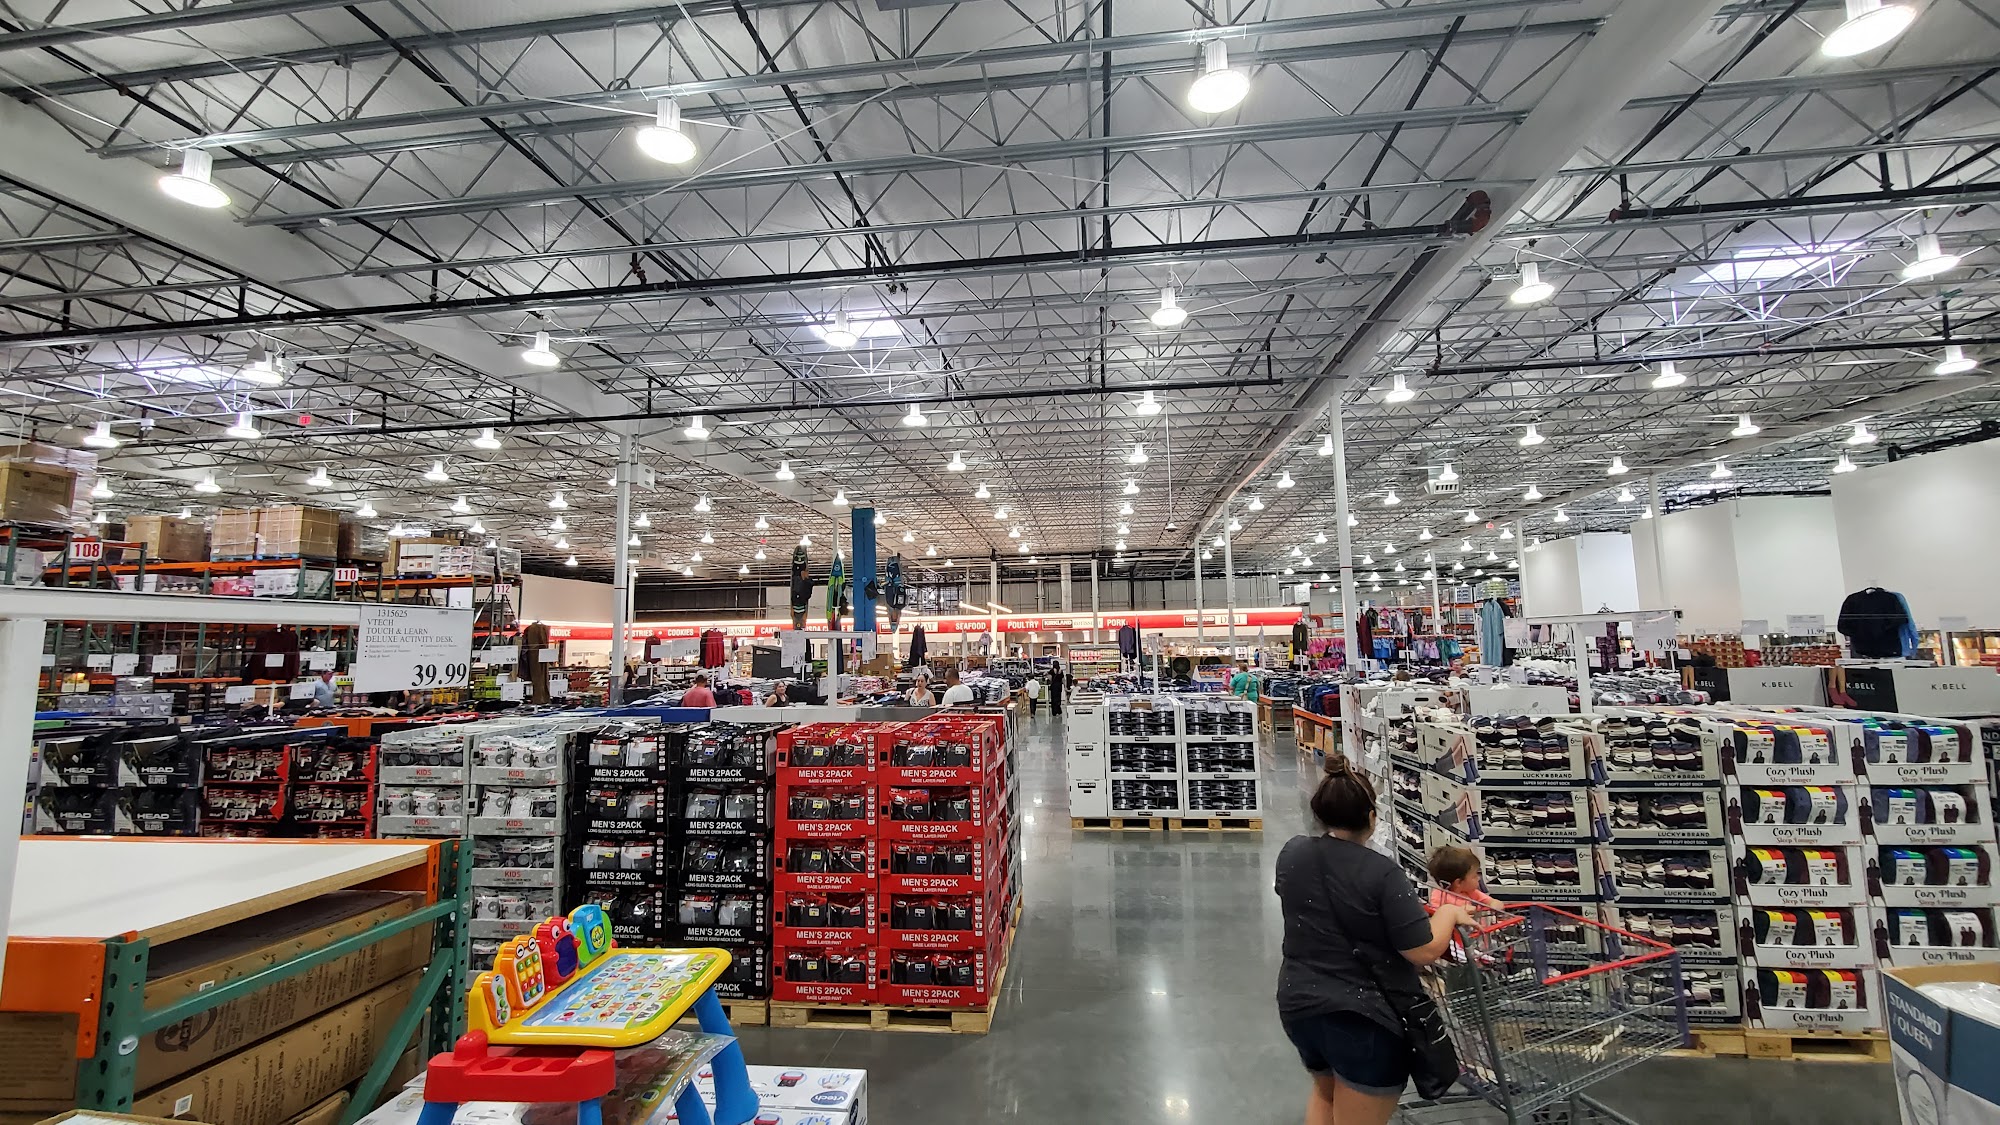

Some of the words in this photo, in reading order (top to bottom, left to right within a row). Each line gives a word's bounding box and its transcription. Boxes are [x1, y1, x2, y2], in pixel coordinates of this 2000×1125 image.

[75, 544, 100, 557] 108
[337, 570, 356, 580] 110
[496, 585, 511, 594] 112
[377, 609, 408, 617] 1315625
[955, 622, 986, 630] SEAFOOD
[1007, 621, 1039, 629] POULTRY
[1106, 619, 1126, 627] PORK
[667, 629, 694, 637] COOKIES
[1657, 639, 1676, 650] 9.99
[411, 663, 467, 686] 39.99
[594, 769, 619, 777] MEN'S
[620, 769, 645, 777] 2PACK
[716, 769, 742, 777] 2PACK
[826, 770, 853, 778] 2PACK
[901, 769, 927, 777] MEN'S
[930, 770, 957, 778] 2PACK
[1766, 767, 1787, 776] Cozy
[1788, 767, 1815, 776] Plush
[1897, 767, 1919, 776] Cozy
[1921, 767, 1948, 776] Plush
[148, 777, 167, 785] GLOVES
[591, 820, 616, 828] MEN'S
[616, 821, 642, 829] 2PACK
[798, 823, 824, 831] MEN'S
[1772, 828, 1794, 837] Cozy
[1796, 827, 1822, 836] Plush
[1905, 827, 1926, 837] Cozy
[1928, 827, 1956, 836] Plush
[590, 872, 615, 880] MEN'S
[616, 872, 642, 880] 2PACK
[689, 874, 714, 882] MEN'S
[716, 875, 742, 883] 2PACK
[825, 876, 852, 884] 2PACK
[901, 878, 929, 886] MEN'S
[930, 878, 958, 887] 2PACK
[1778, 888, 1799, 897] Cozy
[1801, 888, 1828, 897] Plush
[1914, 889, 1936, 899] Cozy
[1939, 890, 1966, 899] Plush
[614, 926, 640, 934] 2PACK
[688, 928, 713, 936] MEN'S
[714, 928, 741, 937] 2PACK
[796, 931, 822, 939] MEN'S
[824, 931, 852, 939] 2PACK
[902, 934, 929, 942] MEN'S
[930, 934, 959, 942] 2PACK
[1785, 950, 1807, 960] Cozy
[1808, 950, 1834, 959] Plush
[1922, 951, 1944, 961] Cozy
[1946, 951, 1975, 960] Plush
[713, 983, 740, 991] 2PACK
[796, 986, 823, 994] MEN'S
[824, 987, 853, 995] 2PACK
[902, 989, 929, 997] MEN'S
[931, 990, 960, 998] 2PACK
[1793, 1012, 1815, 1022] Cozy
[1816, 1013, 1843, 1022] Plush
[1889, 992, 1942, 1035] STANDARD
[1897, 1016, 1933, 1051] QUEEN
